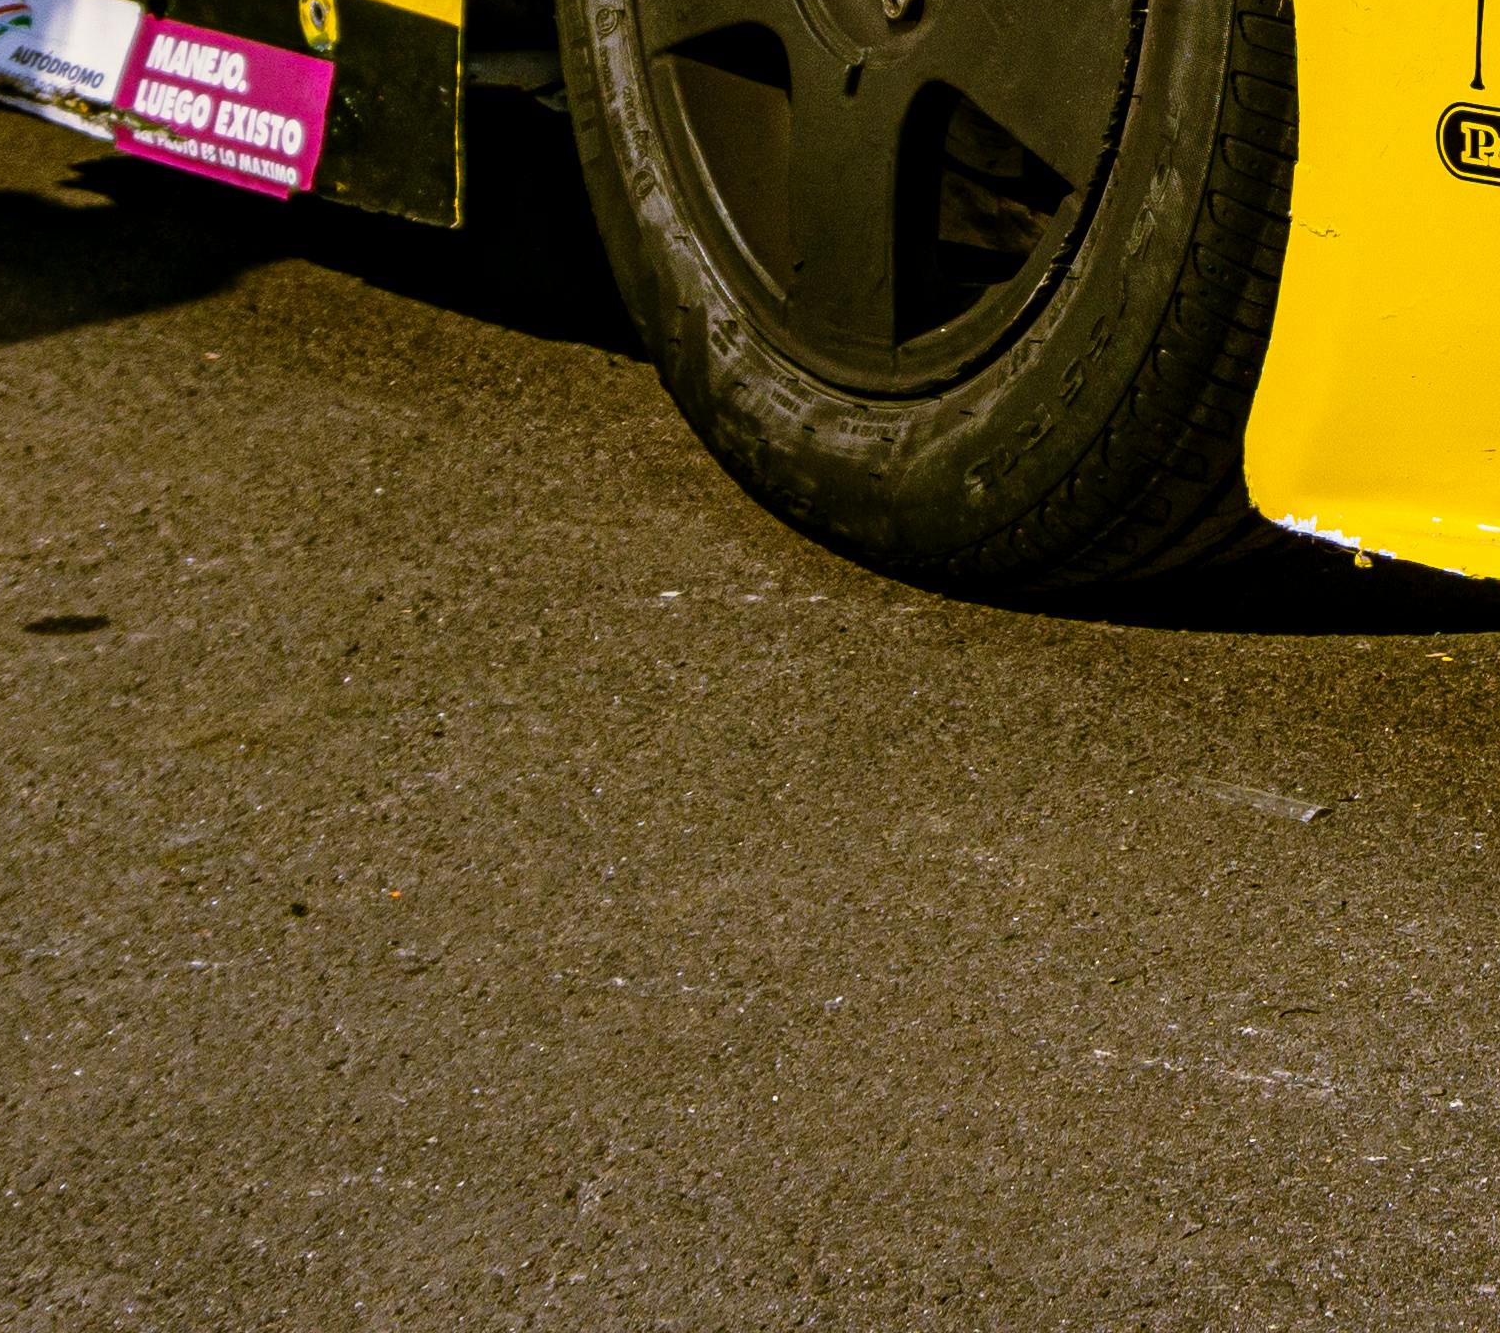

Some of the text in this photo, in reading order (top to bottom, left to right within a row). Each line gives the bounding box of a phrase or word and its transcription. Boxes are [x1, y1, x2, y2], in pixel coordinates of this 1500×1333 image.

[9, 44, 106, 89] AUTÓDROMO
[145, 33, 249, 93] MANEJO.
[133, 78, 304, 156] LUEGO EXISTO
[199, 141, 218, 163] ES
[218, 146, 237, 168] LO
[238, 153, 299, 186] MAXIMO
